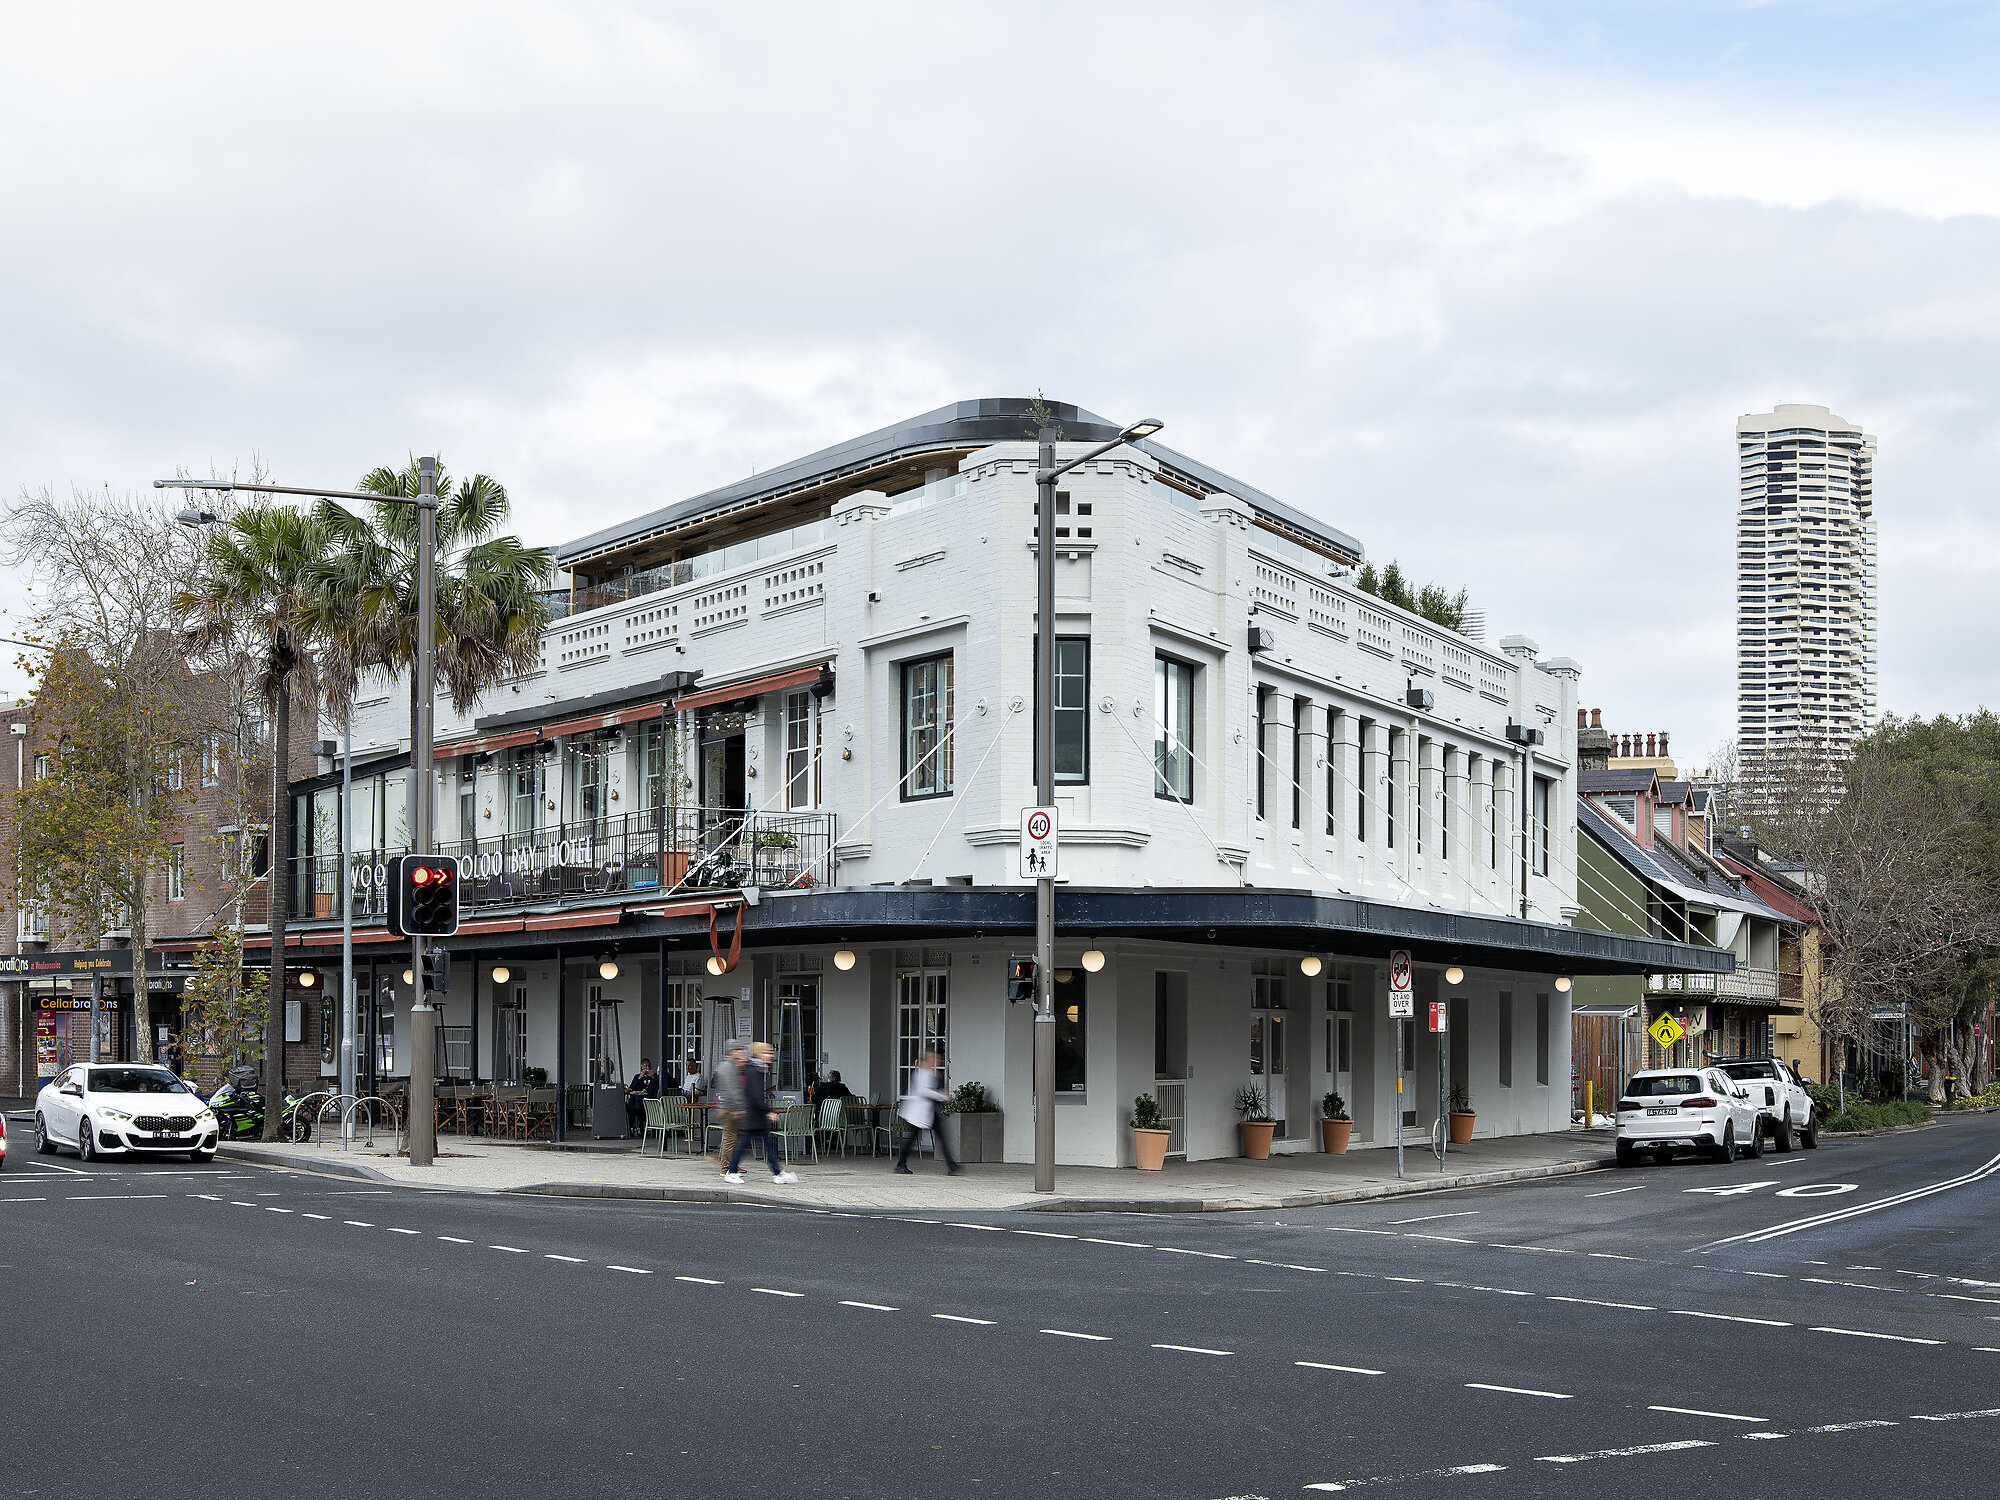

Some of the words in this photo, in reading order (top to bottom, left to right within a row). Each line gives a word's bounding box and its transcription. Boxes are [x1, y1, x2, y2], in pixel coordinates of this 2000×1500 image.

[1032, 820, 1046, 831] 40
[512, 845, 537, 873] BAY
[549, 837, 592, 866] HOTEL
[74, 959, 87, 970] Helping
[95, 958, 112, 968] Celebrate
[40, 998, 118, 1010] Cellarbraons
[1682, 1181, 1859, 1197] 40
